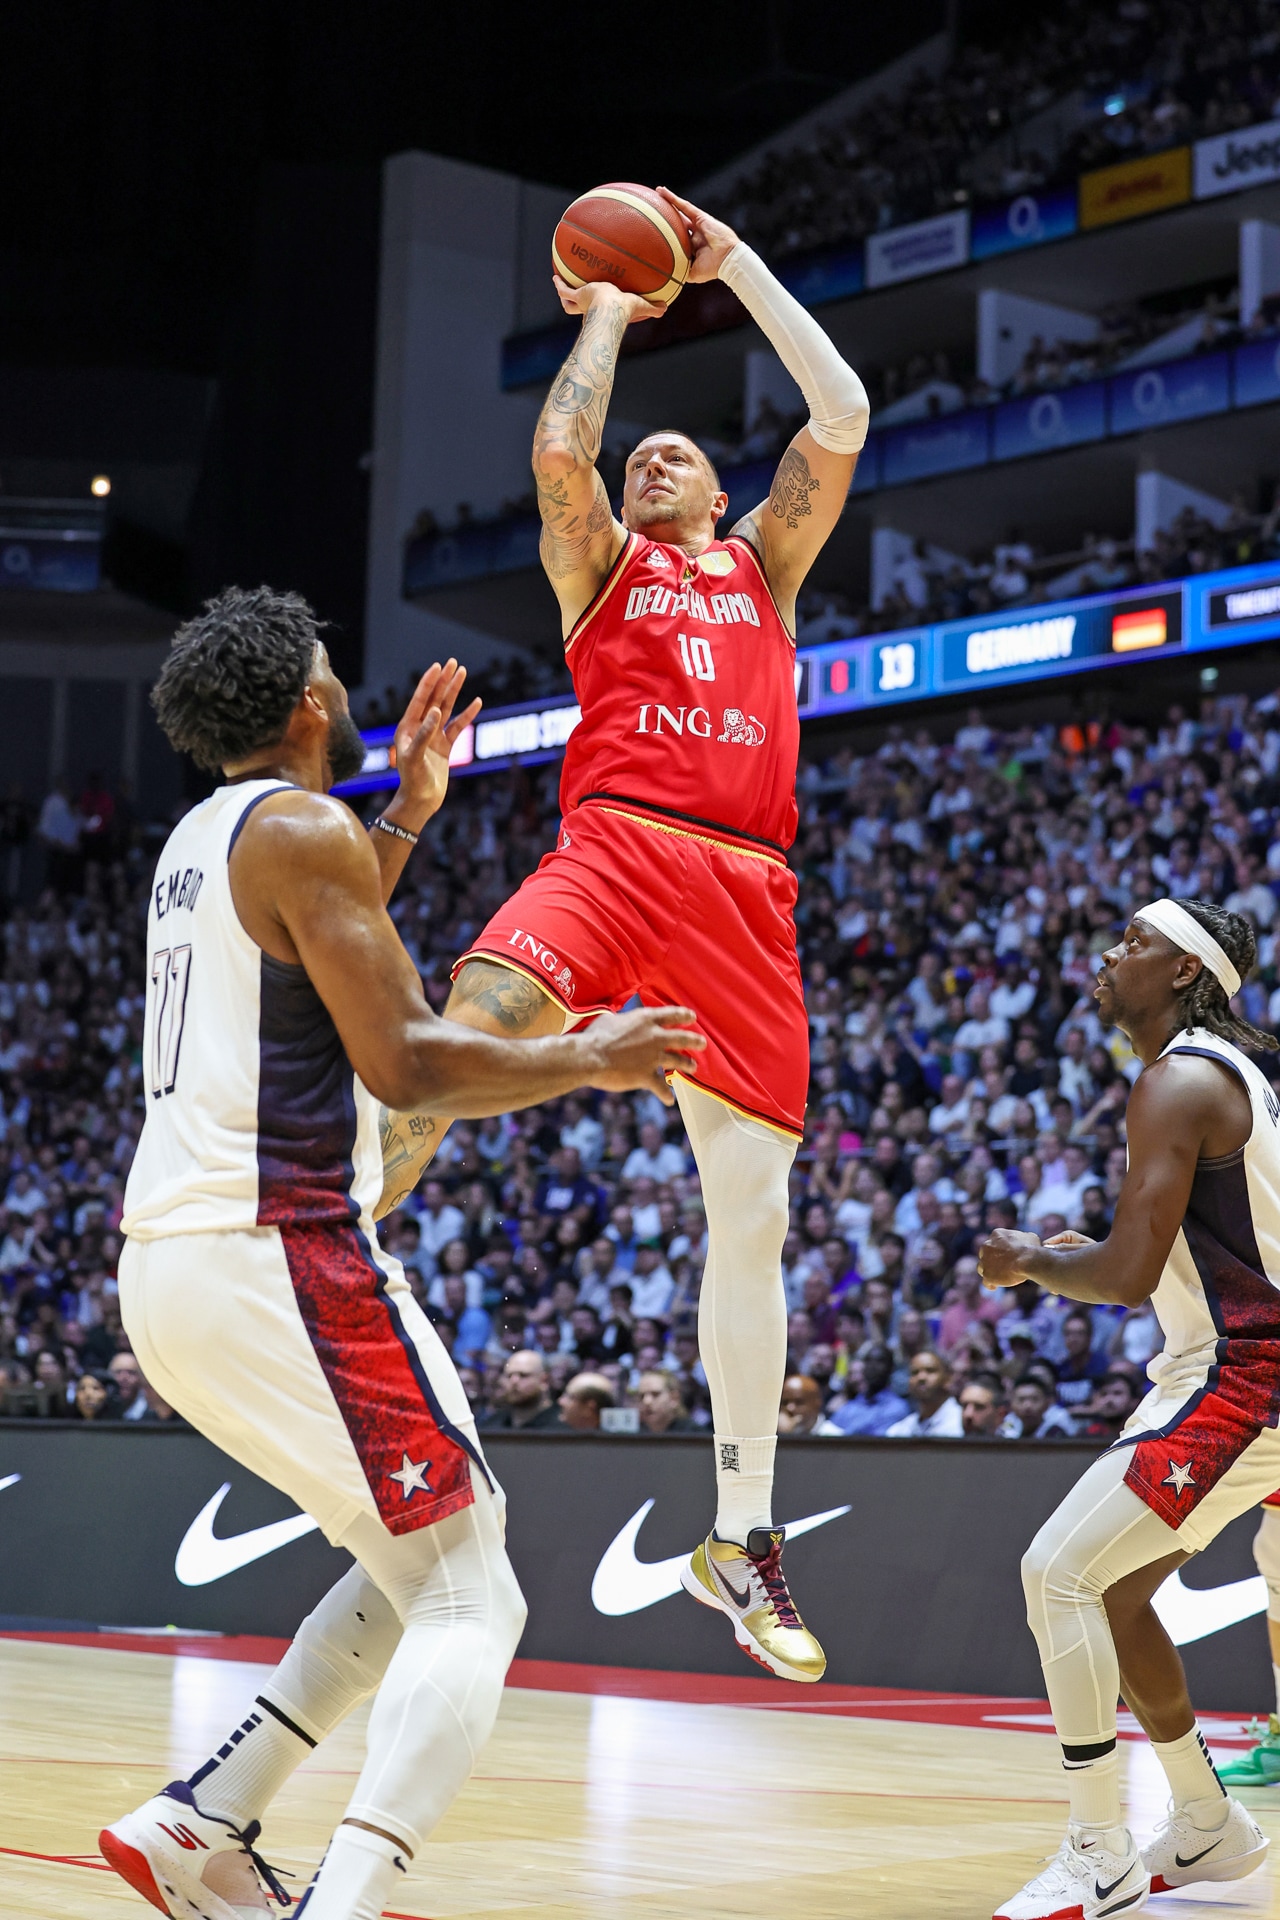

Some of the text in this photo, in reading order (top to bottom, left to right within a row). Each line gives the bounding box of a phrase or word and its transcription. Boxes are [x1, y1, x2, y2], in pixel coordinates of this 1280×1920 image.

[570, 243, 627, 279] molten
[677, 633, 716, 682] 10
[879, 643, 915, 691] 13
[966, 615, 1076, 673] GERMANY
[635, 704, 713, 738] ING
[507, 928, 560, 973] ING
[719, 1442, 740, 1473] PEAK
